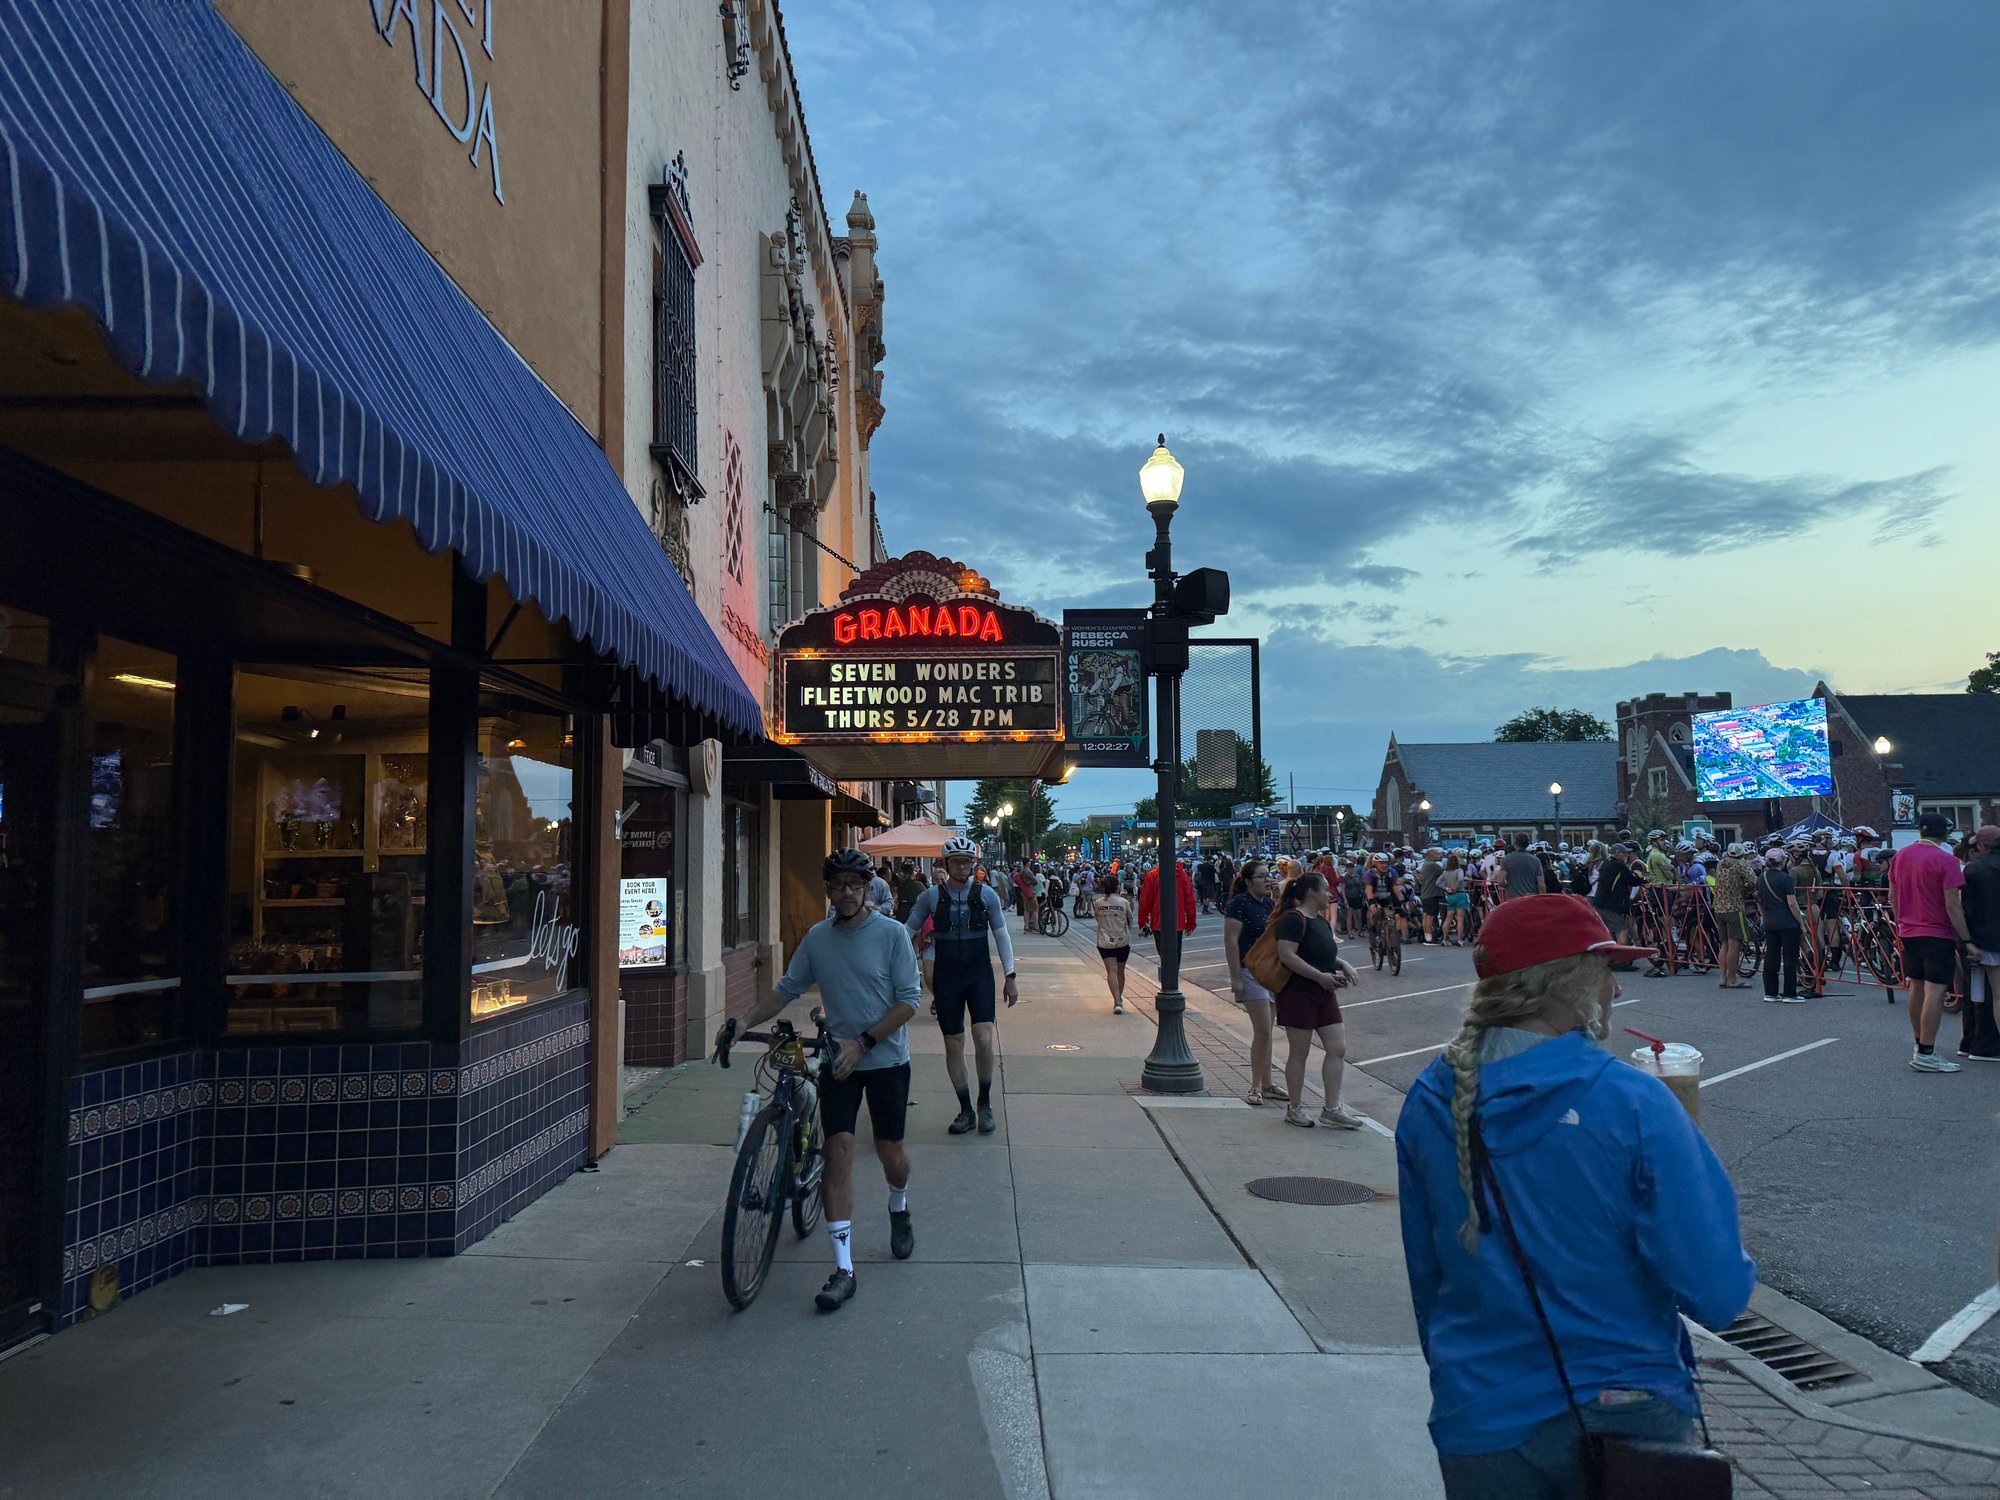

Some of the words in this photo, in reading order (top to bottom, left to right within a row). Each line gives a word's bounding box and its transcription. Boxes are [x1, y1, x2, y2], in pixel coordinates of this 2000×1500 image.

[833, 605, 1003, 645] GRANADA
[1071, 631, 1128, 639] REBECCA
[1071, 639, 1114, 647] RUSCH
[831, 663, 896, 683] SEVEN
[916, 662, 1017, 681] WONDERS
[1069, 654, 1079, 693] 2012
[803, 686, 927, 706] FLEETWOOD
[938, 686, 981, 704] MAC
[992, 685, 1043, 703] TRIB
[824, 709, 896, 729] THURS
[907, 709, 960, 728] 5/28
[970, 709, 1014, 727] 7PM
[1082, 743, 1130, 751] 12:02:27
[774, 1052, 796, 1064] 967
